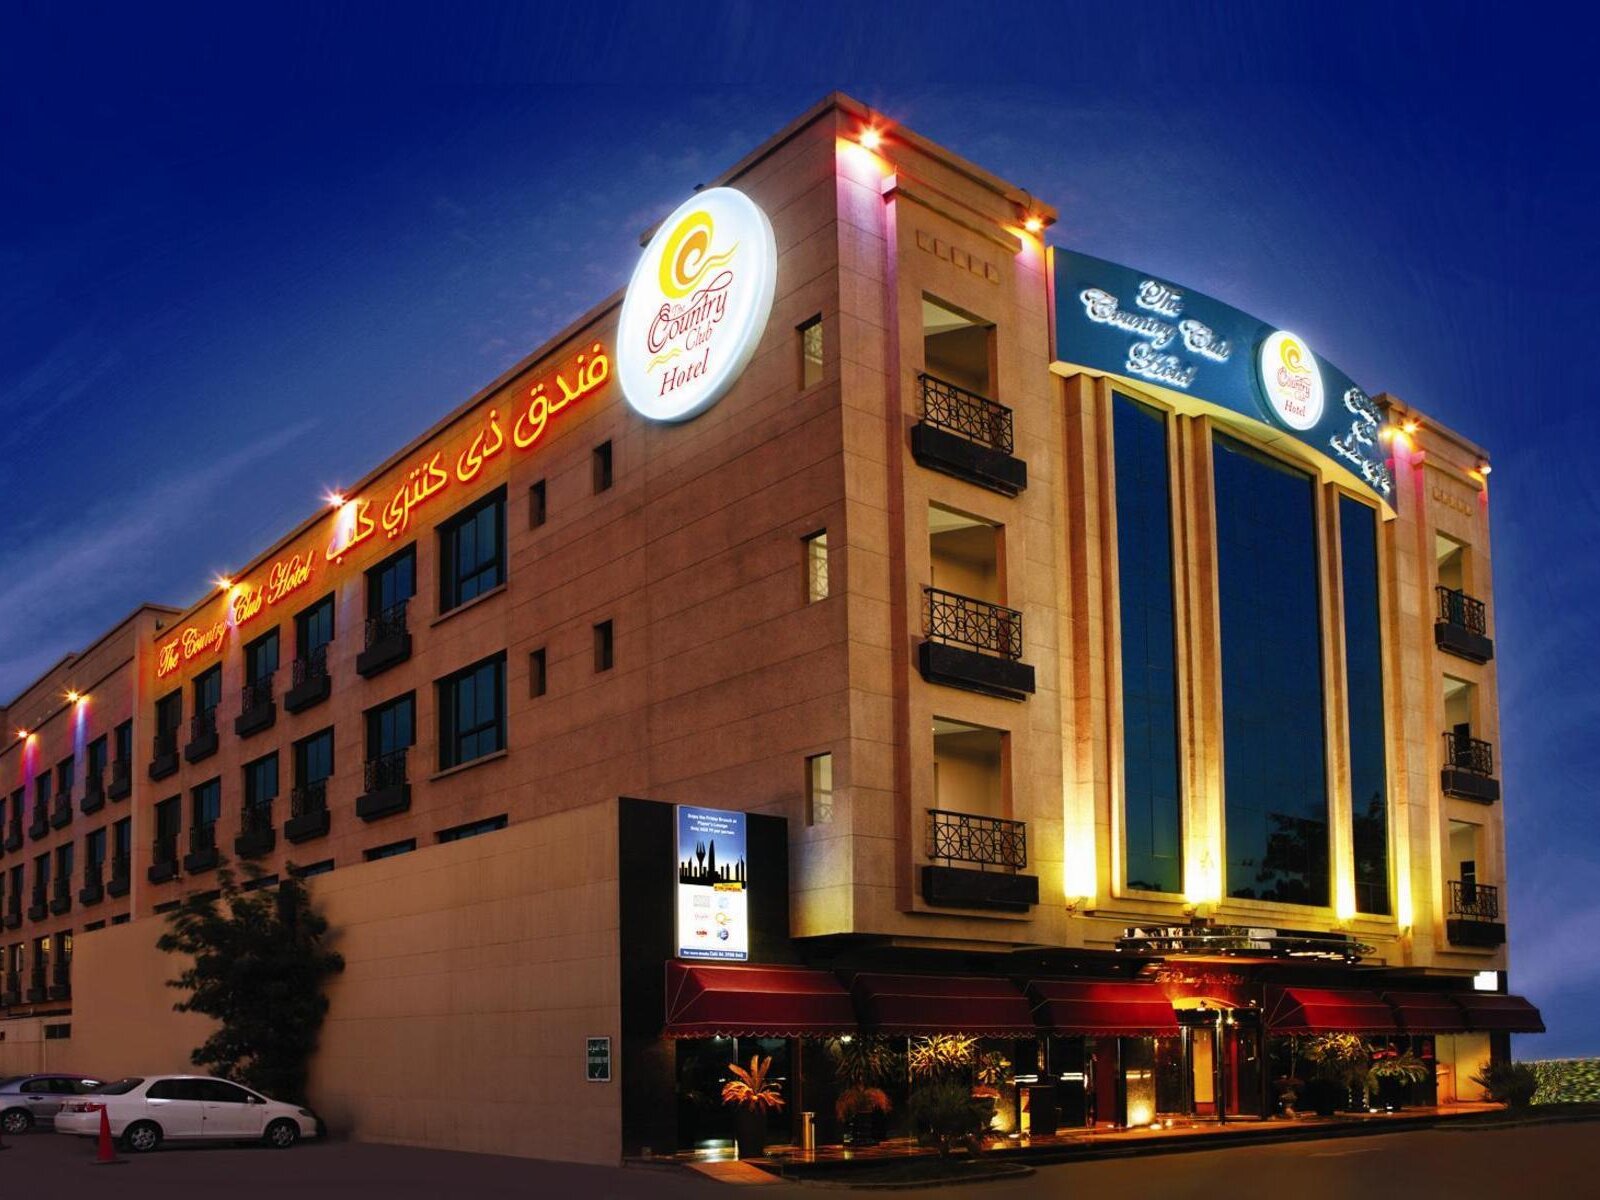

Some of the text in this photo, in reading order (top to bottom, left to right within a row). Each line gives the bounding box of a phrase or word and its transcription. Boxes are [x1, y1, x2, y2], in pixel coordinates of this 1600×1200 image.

[648, 270, 733, 353] Country
[1080, 288, 1232, 362] Country Club
[1136, 280, 1185, 317] The
[686, 320, 712, 351] Club
[514, 343, 609, 448] فندق
[660, 348, 710, 396] Hotel
[1285, 400, 1306, 417] Hotel
[158, 550, 314, 677] The Country Club Hotel
